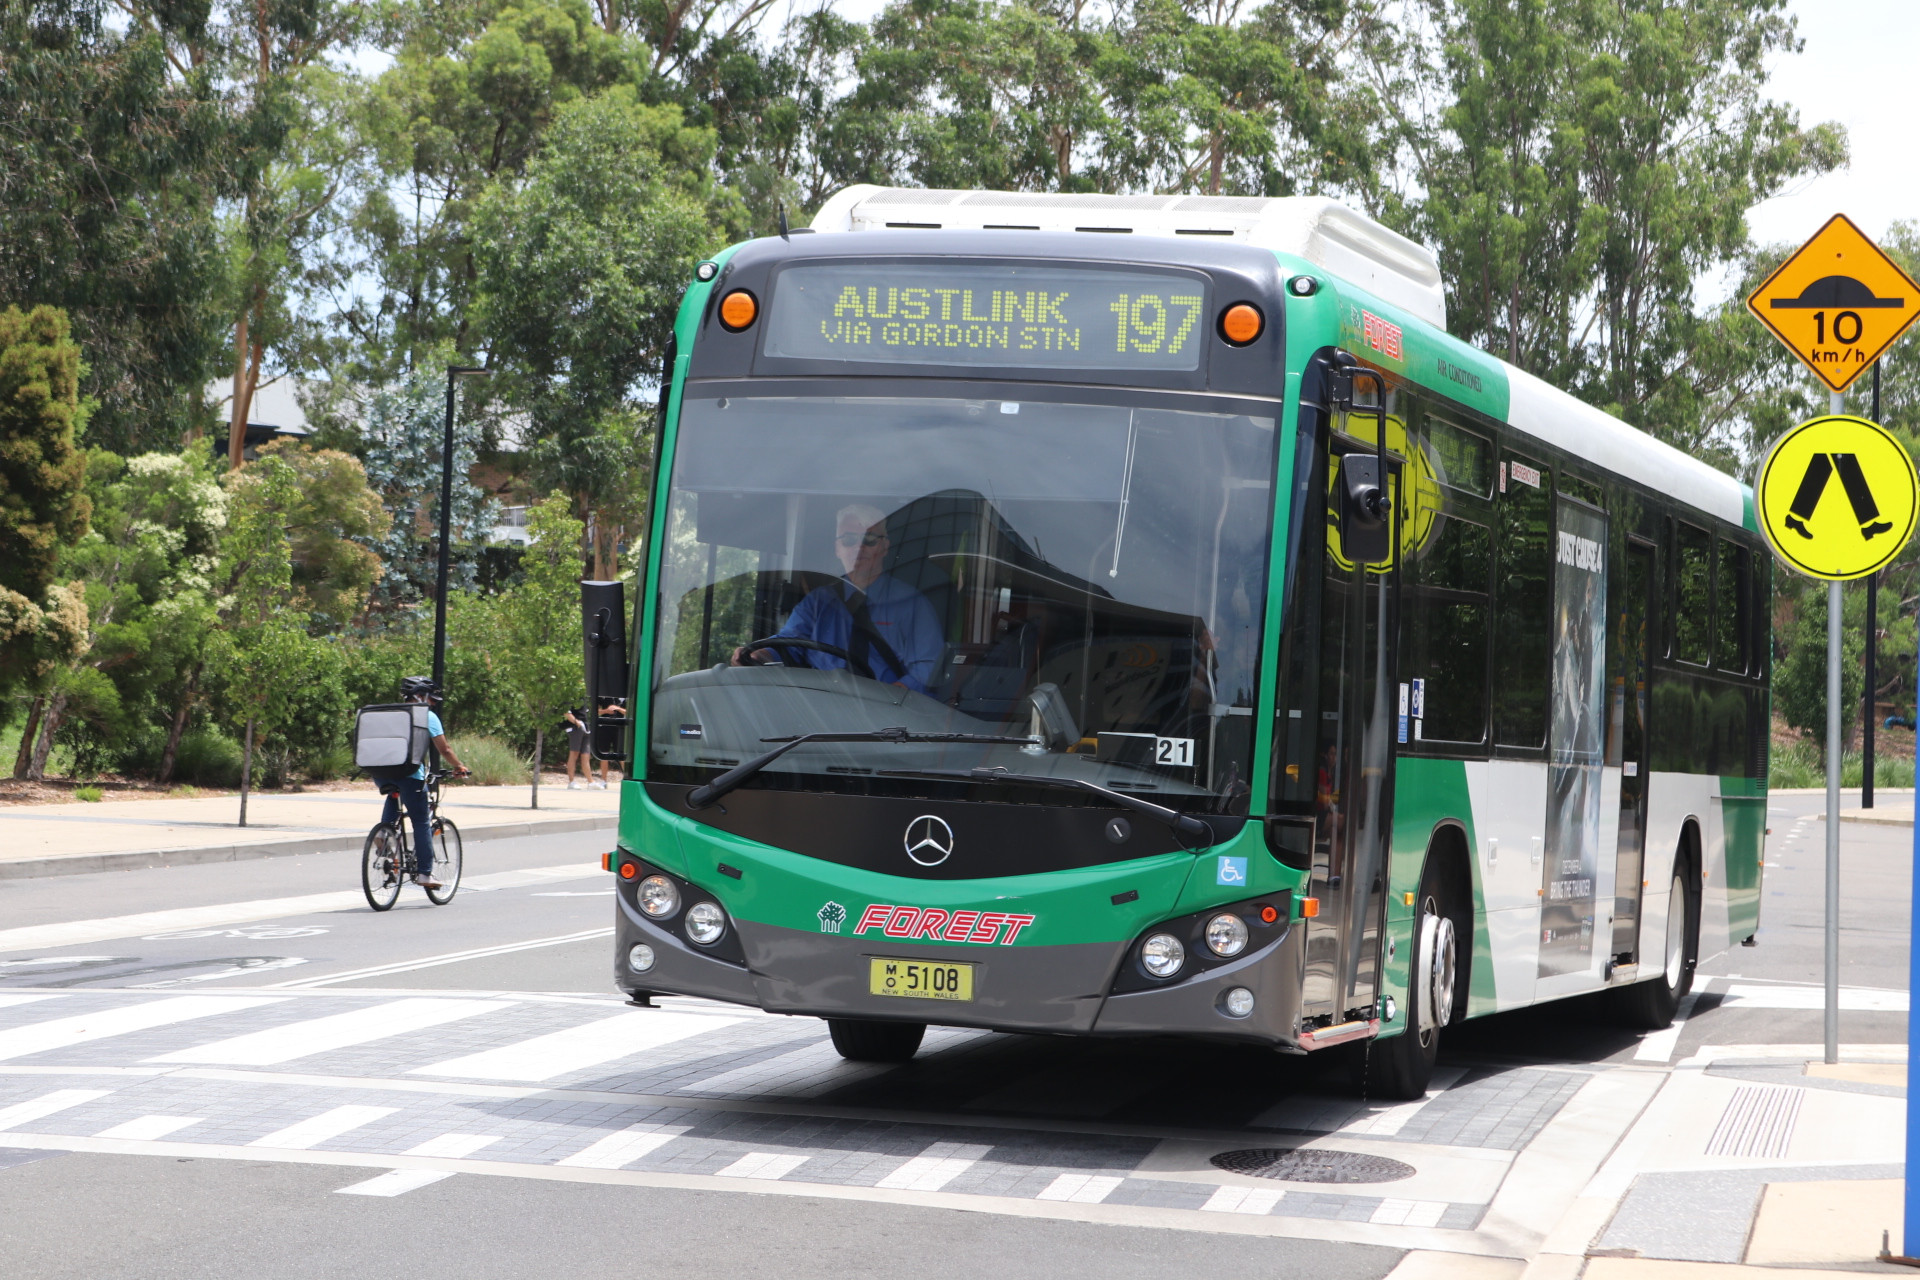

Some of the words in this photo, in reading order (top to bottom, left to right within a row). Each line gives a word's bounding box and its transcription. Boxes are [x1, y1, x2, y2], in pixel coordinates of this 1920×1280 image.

[821, 320, 871, 344] VIA
[882, 322, 1009, 349] GORDON
[1019, 326, 1080, 351] STN
[833, 286, 1069, 324] AUSTLINK
[1109, 293, 1202, 354] 197
[1361, 308, 1403, 362] FOREST
[1813, 311, 1863, 345] 10
[1812, 348, 1865, 362] km/h
[1557, 530, 1577, 566] JUST
[1576, 536, 1597, 573] CAUSE
[1597, 543, 1602, 574] 4
[1158, 740, 1188, 763] 21
[854, 904, 1036, 945] FOREST
